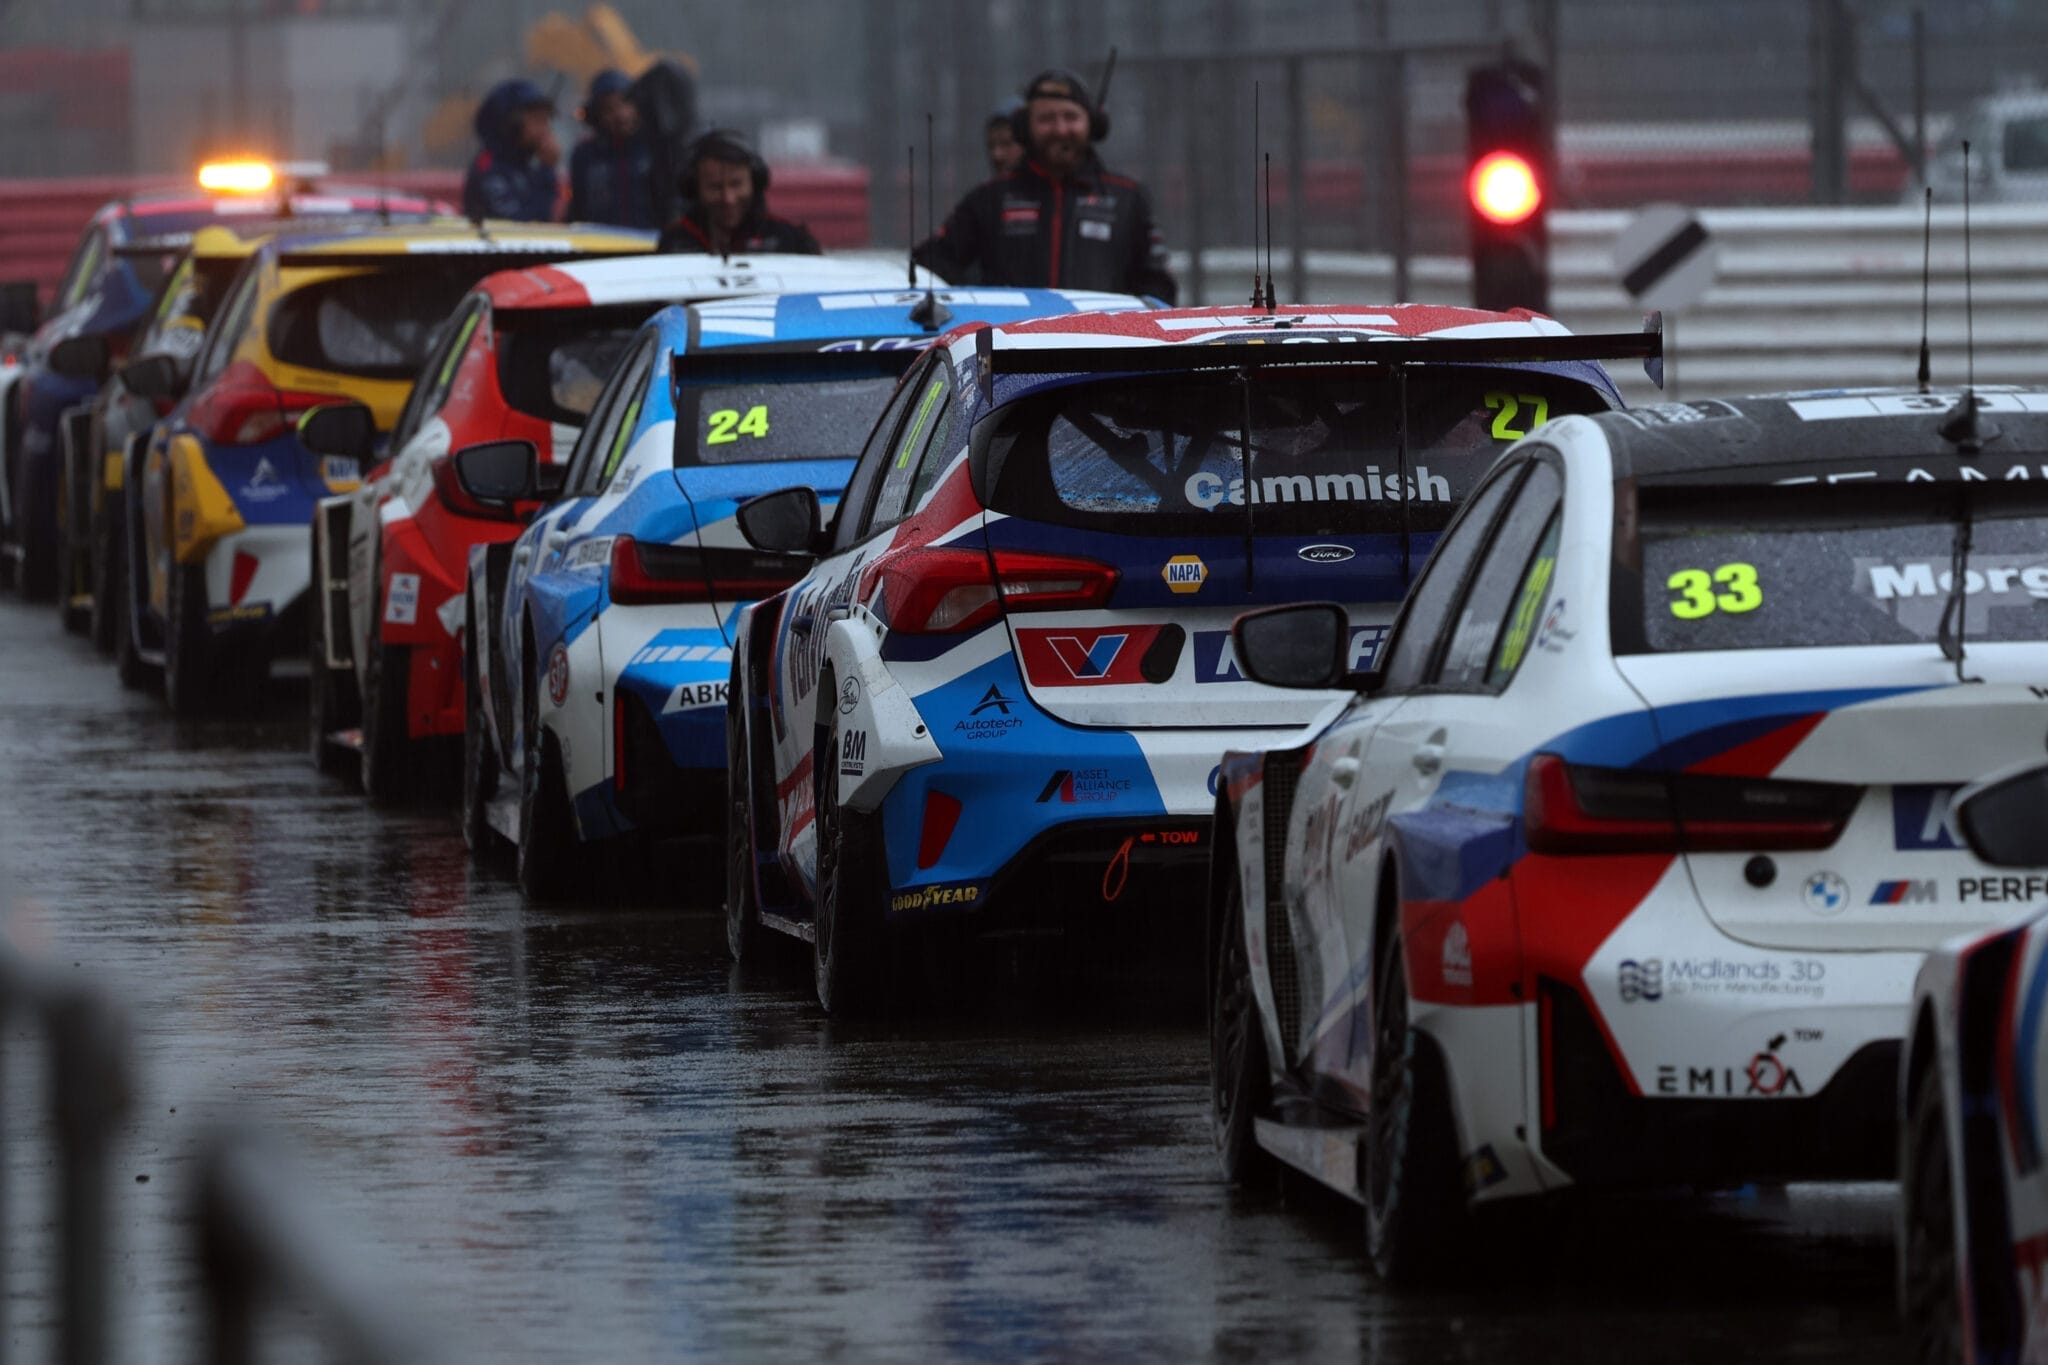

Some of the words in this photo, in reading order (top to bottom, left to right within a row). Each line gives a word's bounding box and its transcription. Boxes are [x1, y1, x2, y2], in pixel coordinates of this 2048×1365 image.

[707, 405, 769, 445] 24
[1484, 390, 1548, 440] 27
[1184, 465, 1451, 509] Cammish
[1169, 563, 1201, 582] NAPA
[1667, 562, 1763, 619] 33
[681, 682, 729, 707] ABK
[954, 717, 1023, 731] Autotech
[967, 730, 1007, 740] GROUP
[842, 729, 866, 760] BM
[1076, 769, 1109, 779] ASSET
[1076, 780, 1131, 791] ALLIANCE
[1076, 791, 1117, 801] GROUP
[1160, 832, 1198, 843] TOW
[892, 885, 978, 911] GOODYEAR
[1958, 877, 2048, 902] PERF
[1669, 958, 1781, 980] Midlands
[1789, 959, 1826, 981] 3D
[1793, 1029, 1824, 1041] TOW
[1657, 1065, 1804, 1093] EMIXA
